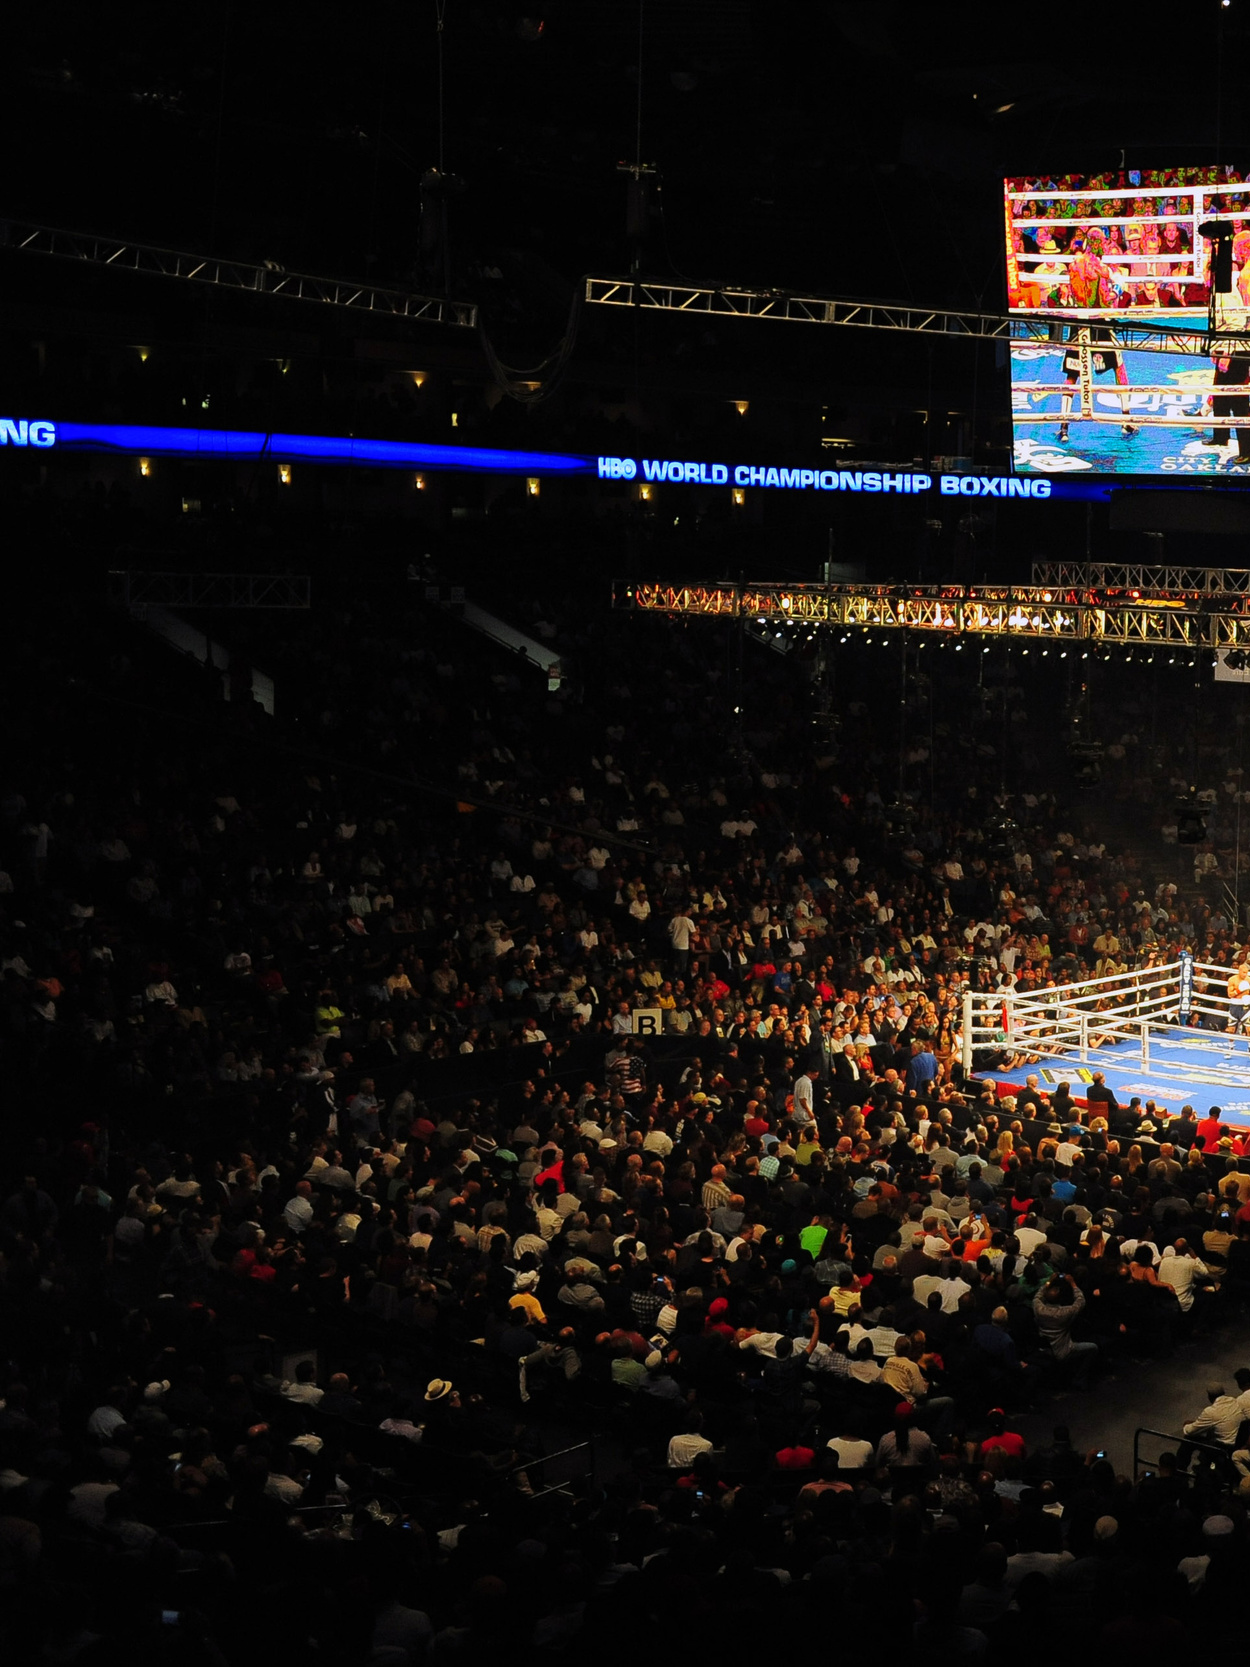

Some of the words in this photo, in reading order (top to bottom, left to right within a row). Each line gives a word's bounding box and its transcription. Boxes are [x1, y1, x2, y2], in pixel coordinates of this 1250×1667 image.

[1082, 379, 1090, 405] Tutor
[0, 419, 55, 447] NG
[1162, 456, 1214, 464] CITY
[598, 457, 637, 480] HBO
[642, 460, 728, 484] WORLD
[734, 466, 932, 494] CHAMPIONSHIP
[940, 475, 1051, 498] BOXING
[638, 1016, 656, 1035] B
